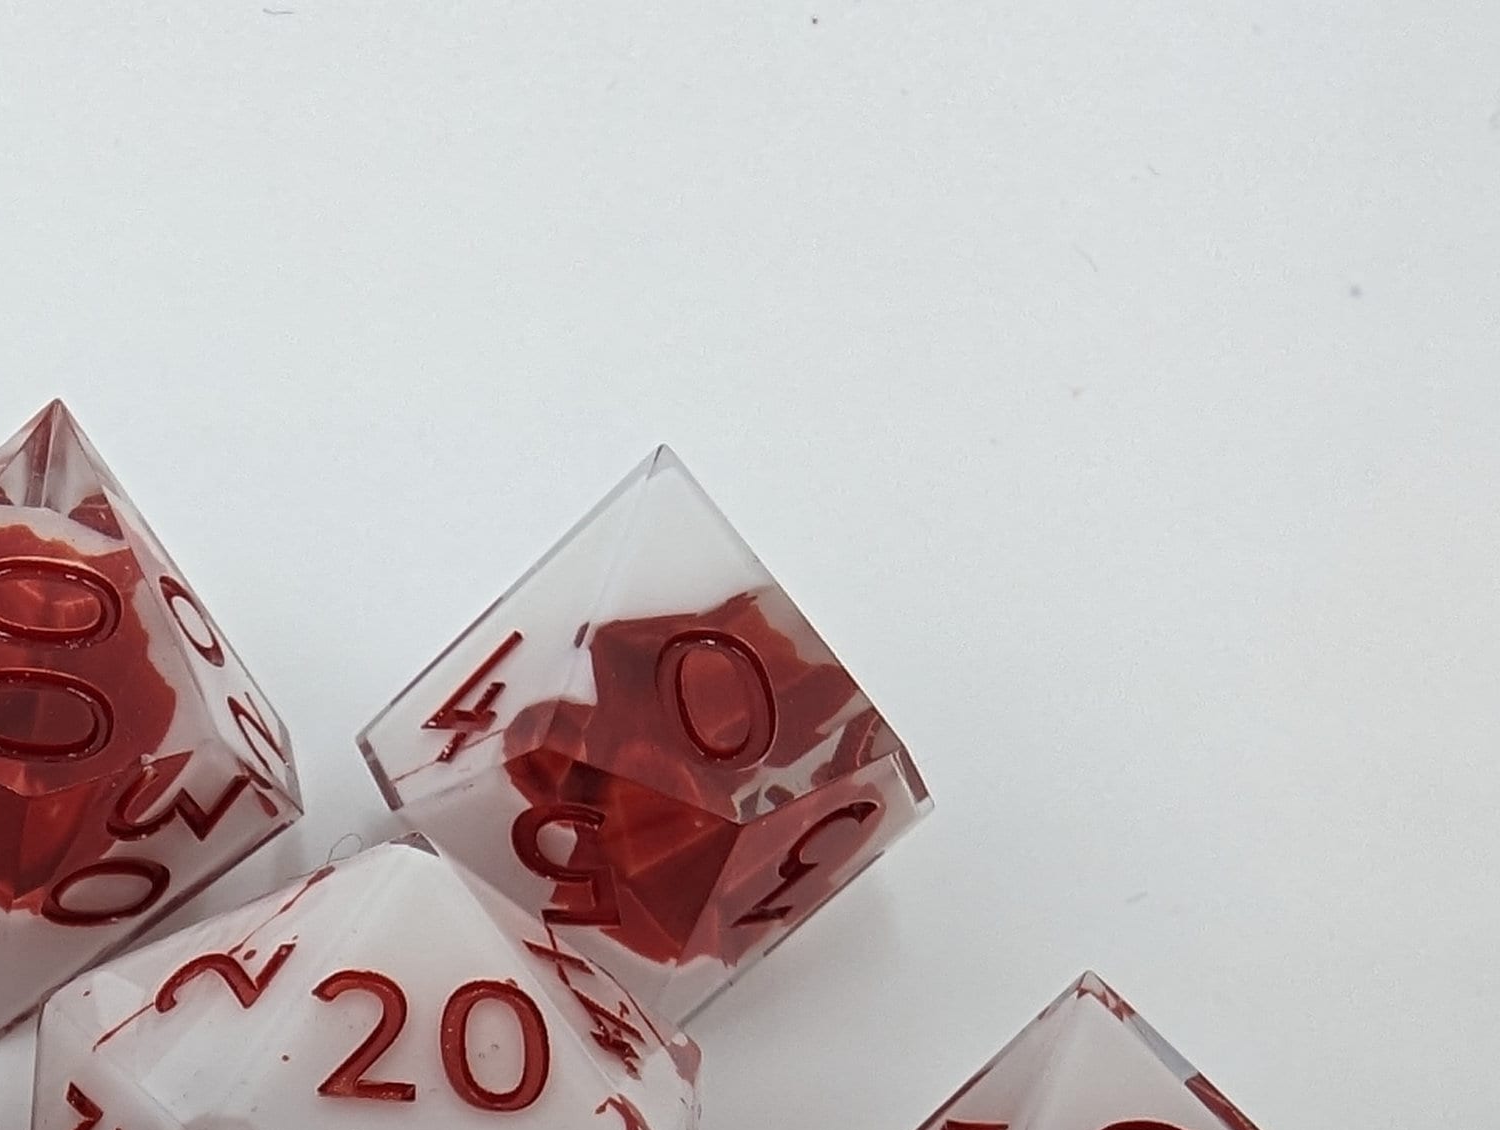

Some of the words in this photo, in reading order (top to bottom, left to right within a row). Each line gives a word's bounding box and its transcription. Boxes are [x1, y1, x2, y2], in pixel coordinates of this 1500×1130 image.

[420, 630, 524, 763] 4
[655, 629, 778, 771] 0
[312, 969, 551, 1114] 20
